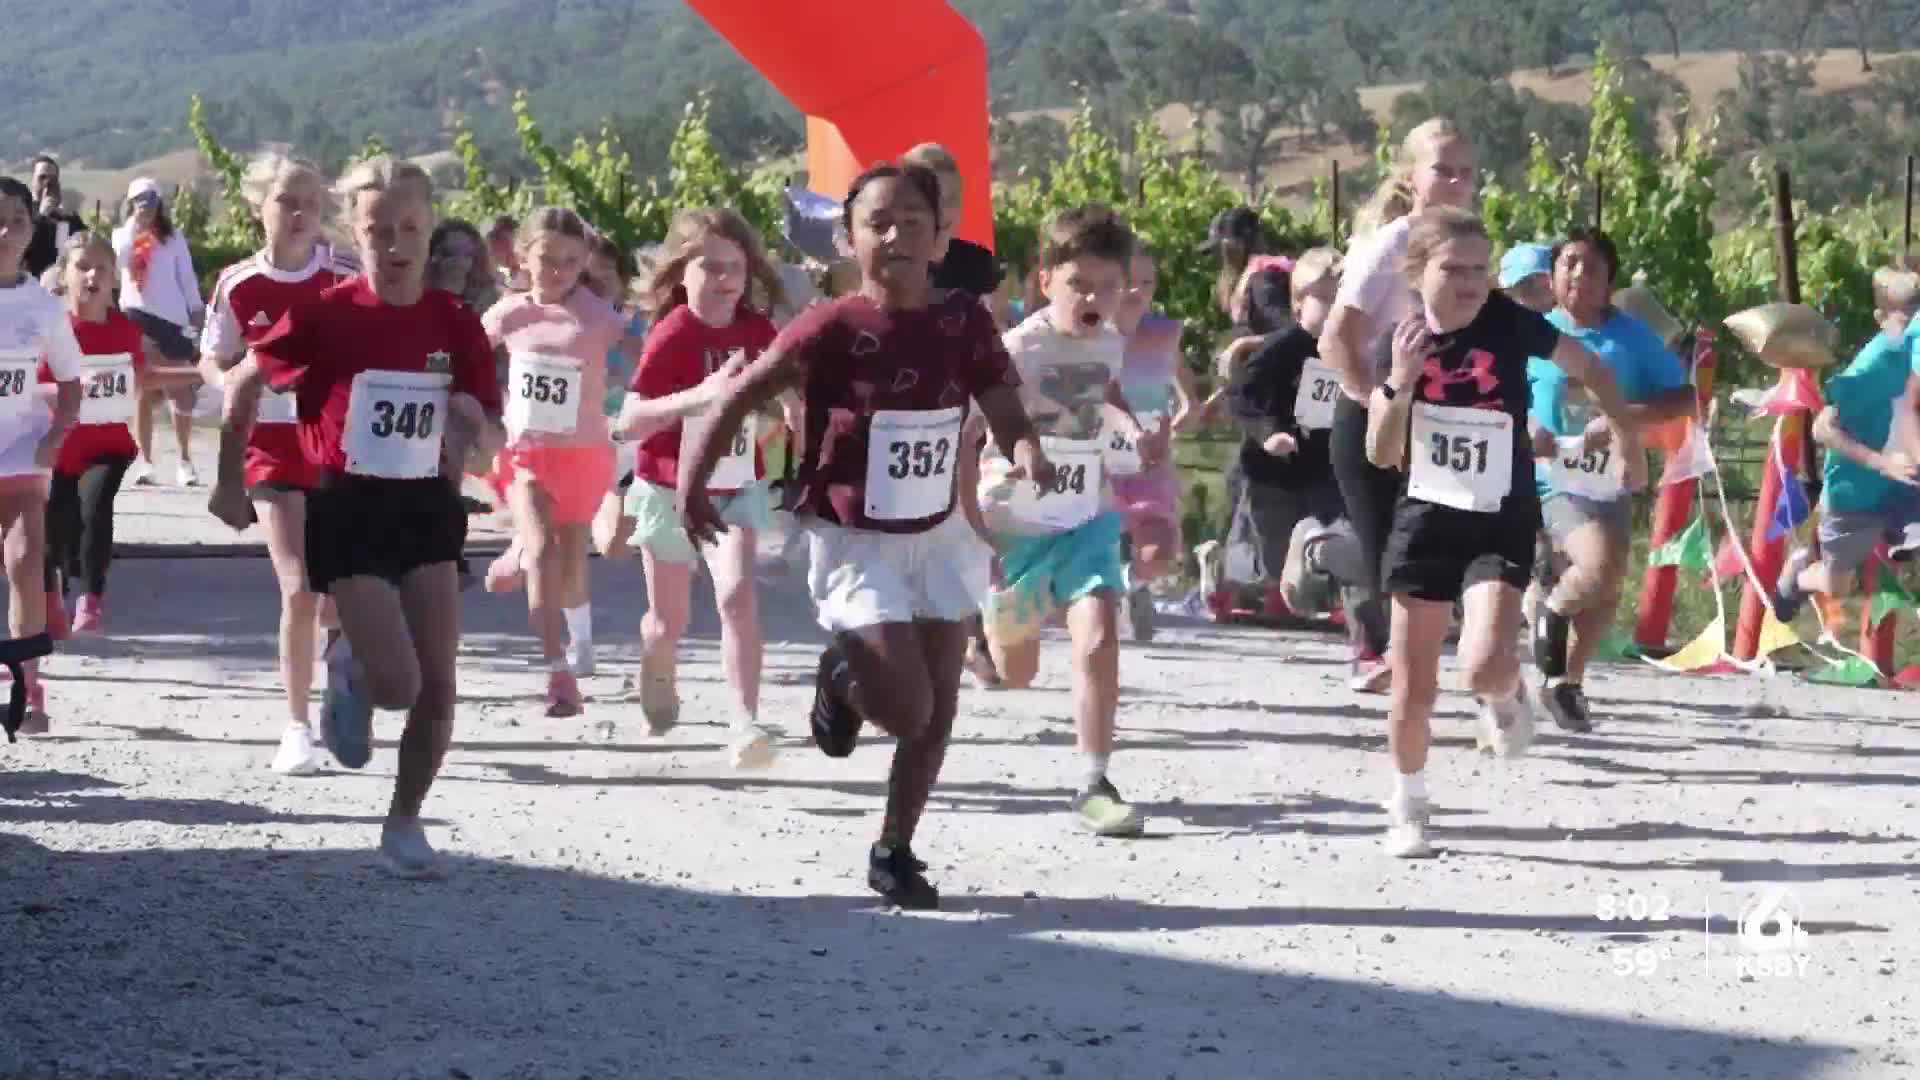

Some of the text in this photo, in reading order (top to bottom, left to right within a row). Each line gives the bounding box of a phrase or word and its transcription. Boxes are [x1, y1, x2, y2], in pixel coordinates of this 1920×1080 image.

[521, 373, 568, 405] 353
[371, 400, 434, 439] 348
[888, 437, 950, 479] 352
[1431, 431, 1488, 473] 351
[1053, 463, 1086, 494] 84
